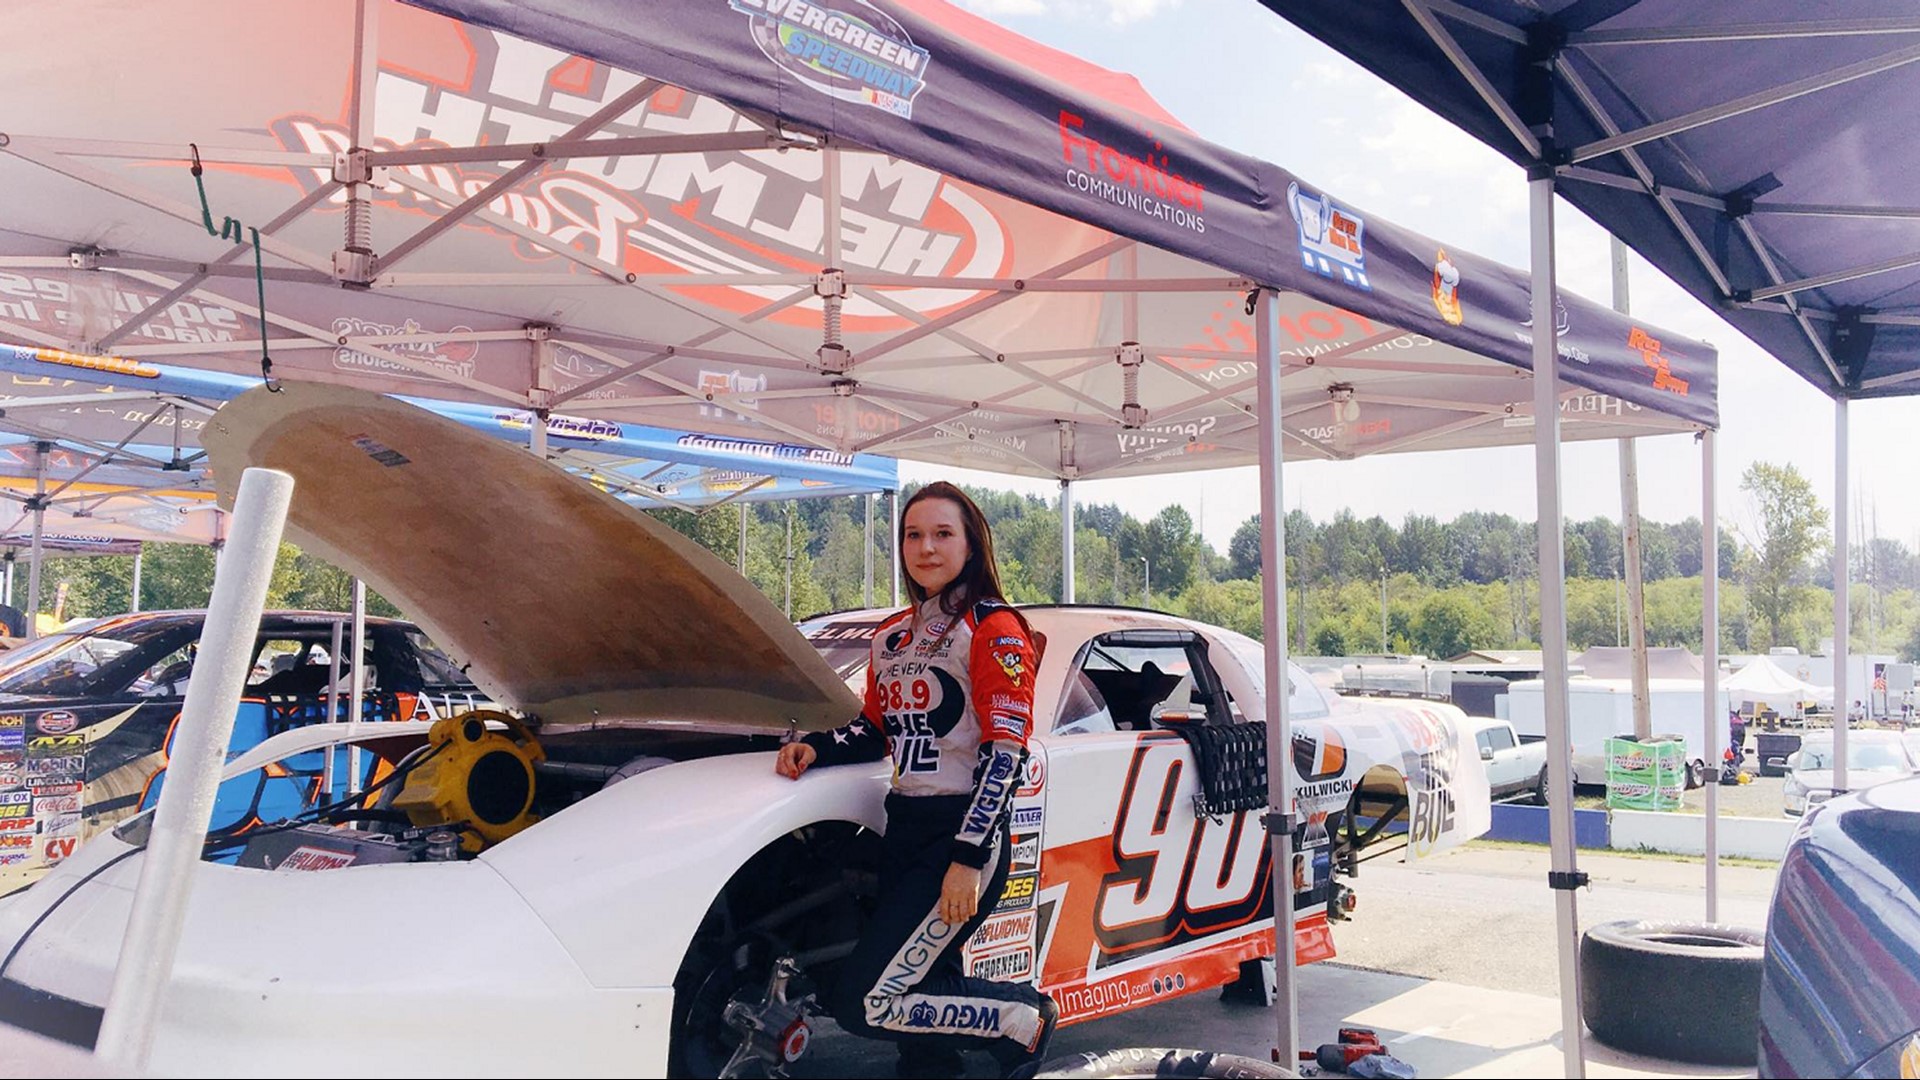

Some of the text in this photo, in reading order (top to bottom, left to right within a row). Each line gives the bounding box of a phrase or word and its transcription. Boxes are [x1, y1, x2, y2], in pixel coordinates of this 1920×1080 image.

[747, 0, 922, 71] VERGREEN
[784, 31, 920, 98] SPEEDWAY
[1059, 110, 1206, 212] Frontier
[1066, 169, 1206, 234] COMMUNICATIONS
[878, 679, 931, 713] 98.9
[993, 717, 1022, 732] CHAMPION
[13, 793, 28, 802] OX
[963, 778, 1005, 835] WGU
[1297, 779, 1353, 800] KULWICKI
[45, 838, 77, 859] CV
[1099, 738, 1270, 930] 90
[974, 951, 1029, 979] SCHOENFELD
[937, 1003, 1000, 1032] WGU
